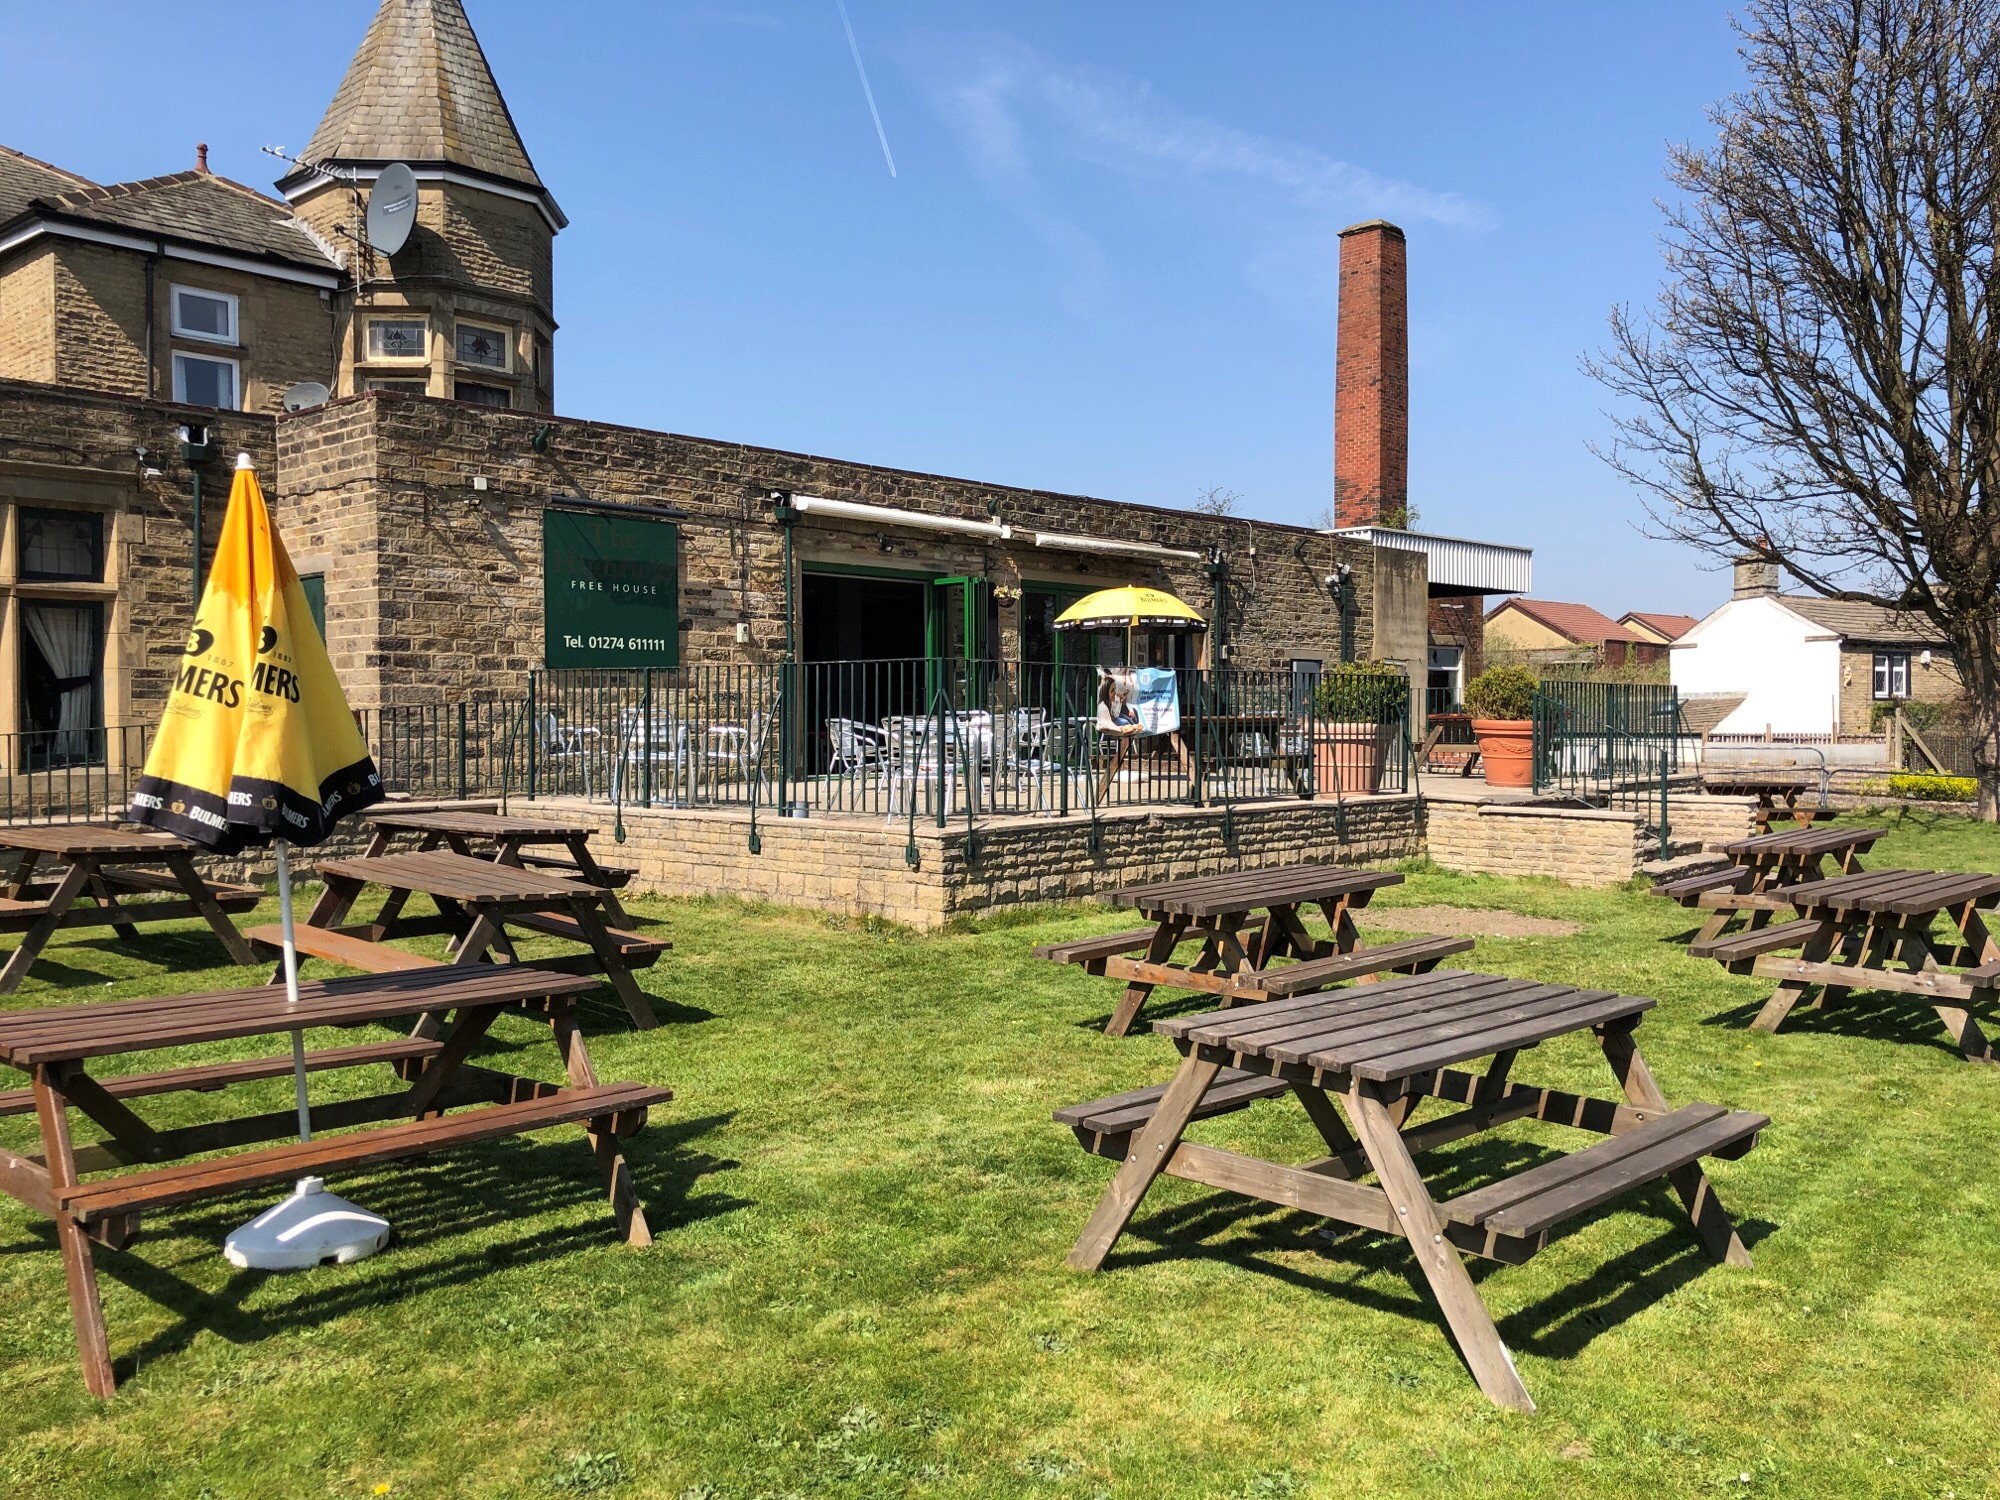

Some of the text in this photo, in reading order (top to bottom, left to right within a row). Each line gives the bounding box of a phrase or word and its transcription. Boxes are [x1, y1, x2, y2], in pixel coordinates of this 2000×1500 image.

[571, 580, 657, 595] FREE HOUSE
[563, 635, 665, 651] Tel. 01274 611111
[207, 654, 234, 668] 1887
[273, 651, 292, 663] 1887
